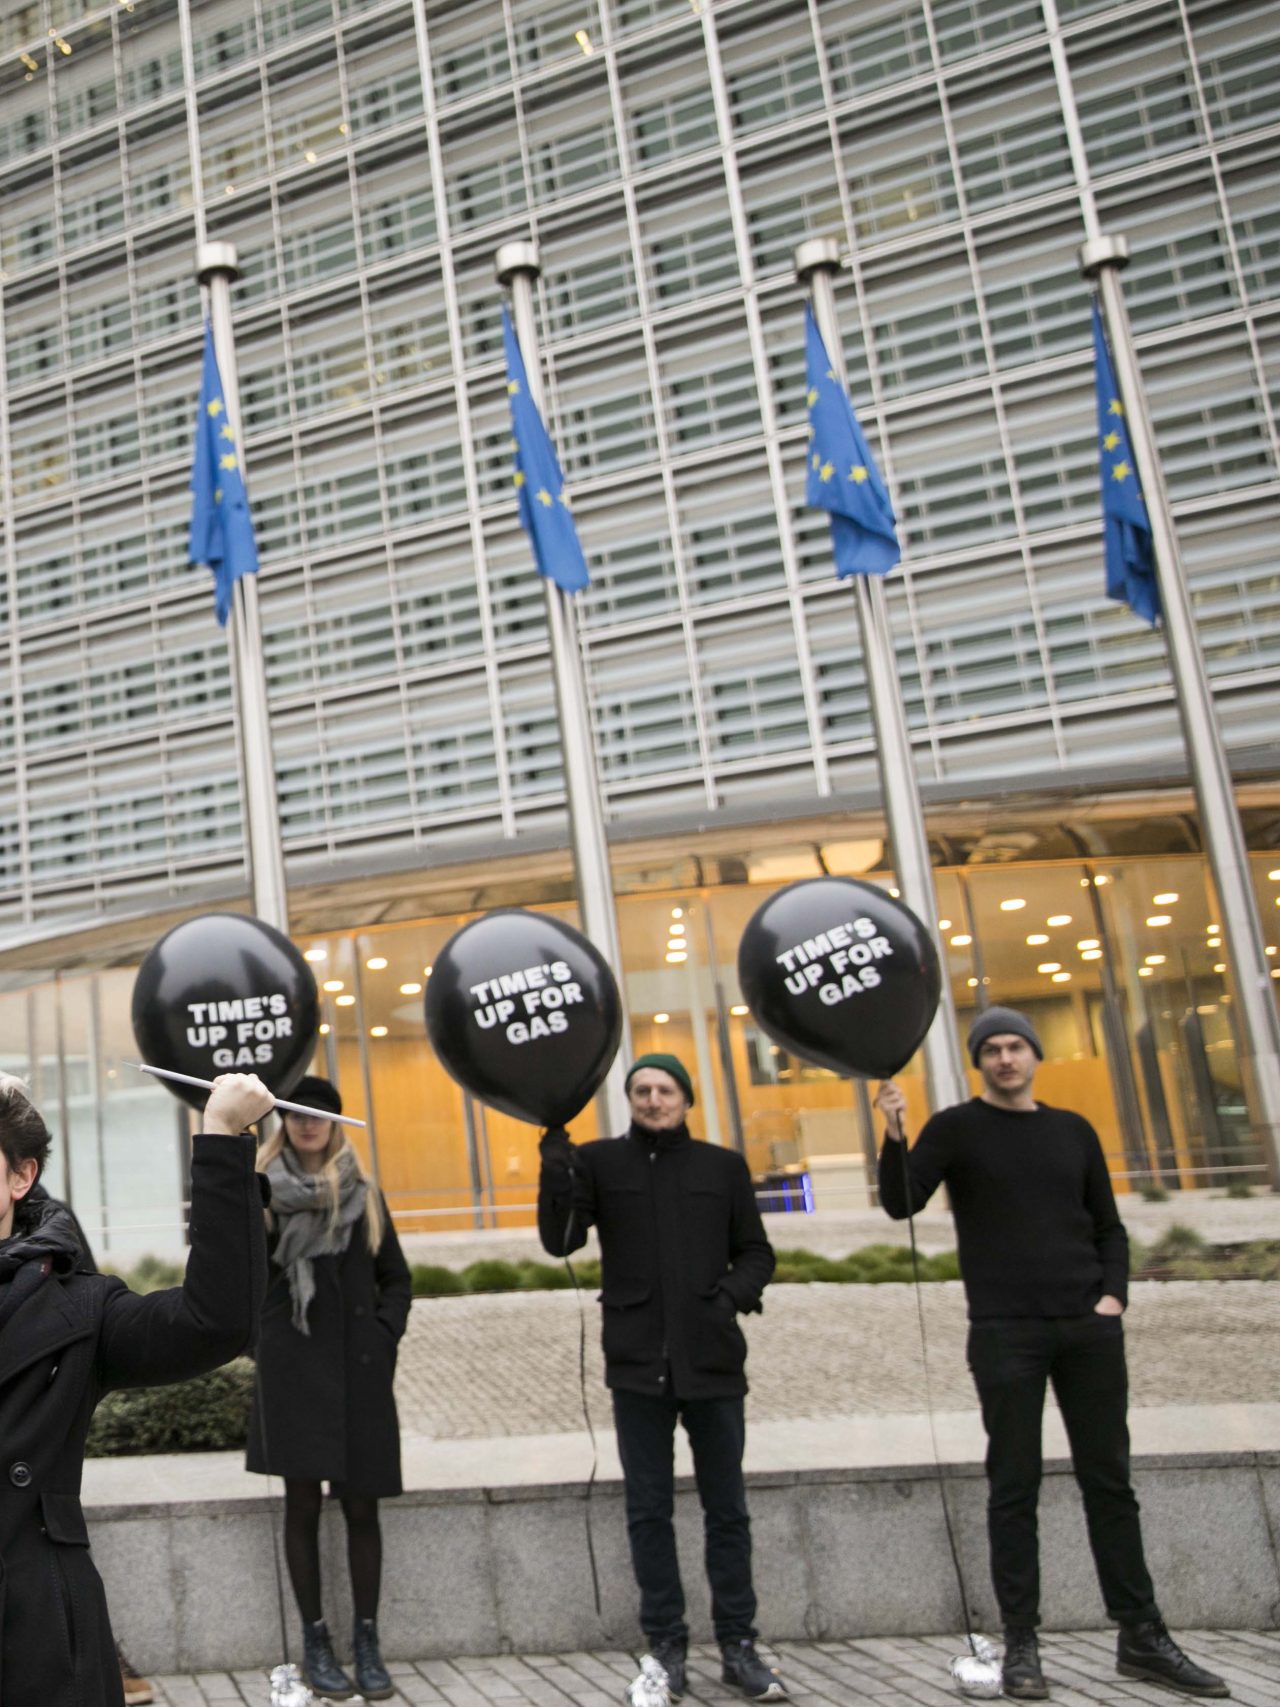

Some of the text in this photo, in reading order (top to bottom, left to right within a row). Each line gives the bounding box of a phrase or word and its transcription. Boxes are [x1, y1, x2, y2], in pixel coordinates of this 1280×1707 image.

[776, 917, 877, 972] TIME'S
[470, 961, 572, 1005] TIME'S
[783, 936, 894, 995] UP FOR
[474, 982, 584, 1029] UP FOR
[818, 966, 882, 1006] GAS
[187, 994, 287, 1024] TIME'S
[506, 1010, 569, 1045] GAS
[186, 1017, 293, 1047] UP FOR
[212, 1043, 273, 1068] GAS
